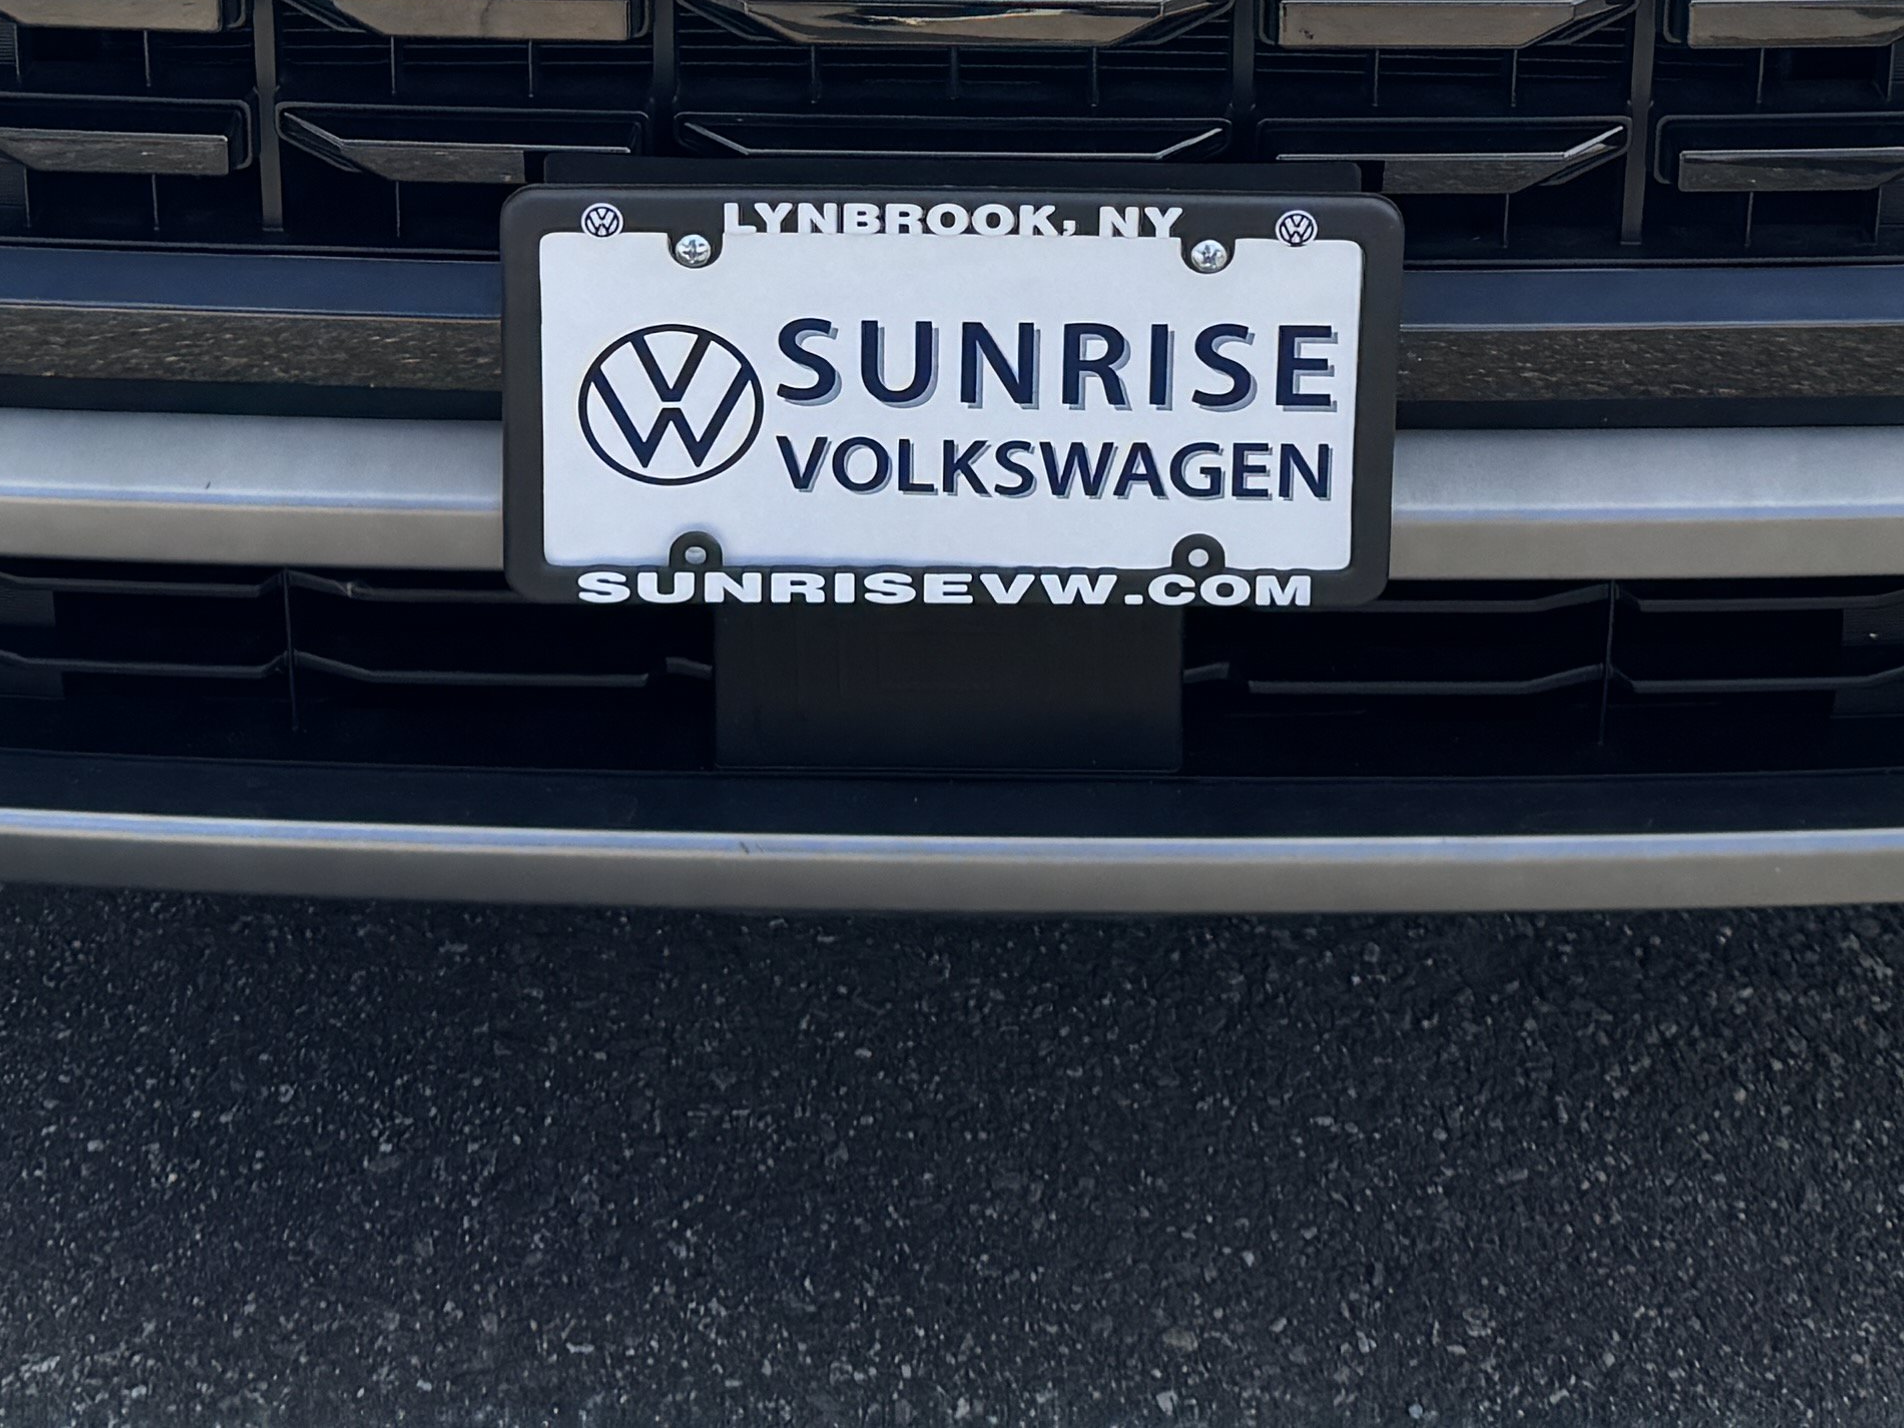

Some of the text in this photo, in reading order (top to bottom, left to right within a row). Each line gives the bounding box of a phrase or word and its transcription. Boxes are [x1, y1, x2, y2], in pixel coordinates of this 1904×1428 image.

[723, 201, 1184, 239] LYNBROOK, NY
[775, 317, 1337, 412] SUNRISE
[775, 434, 1333, 501] VOLKSWAGEN
[578, 571, 1312, 607] SUNRISEVW.COM
